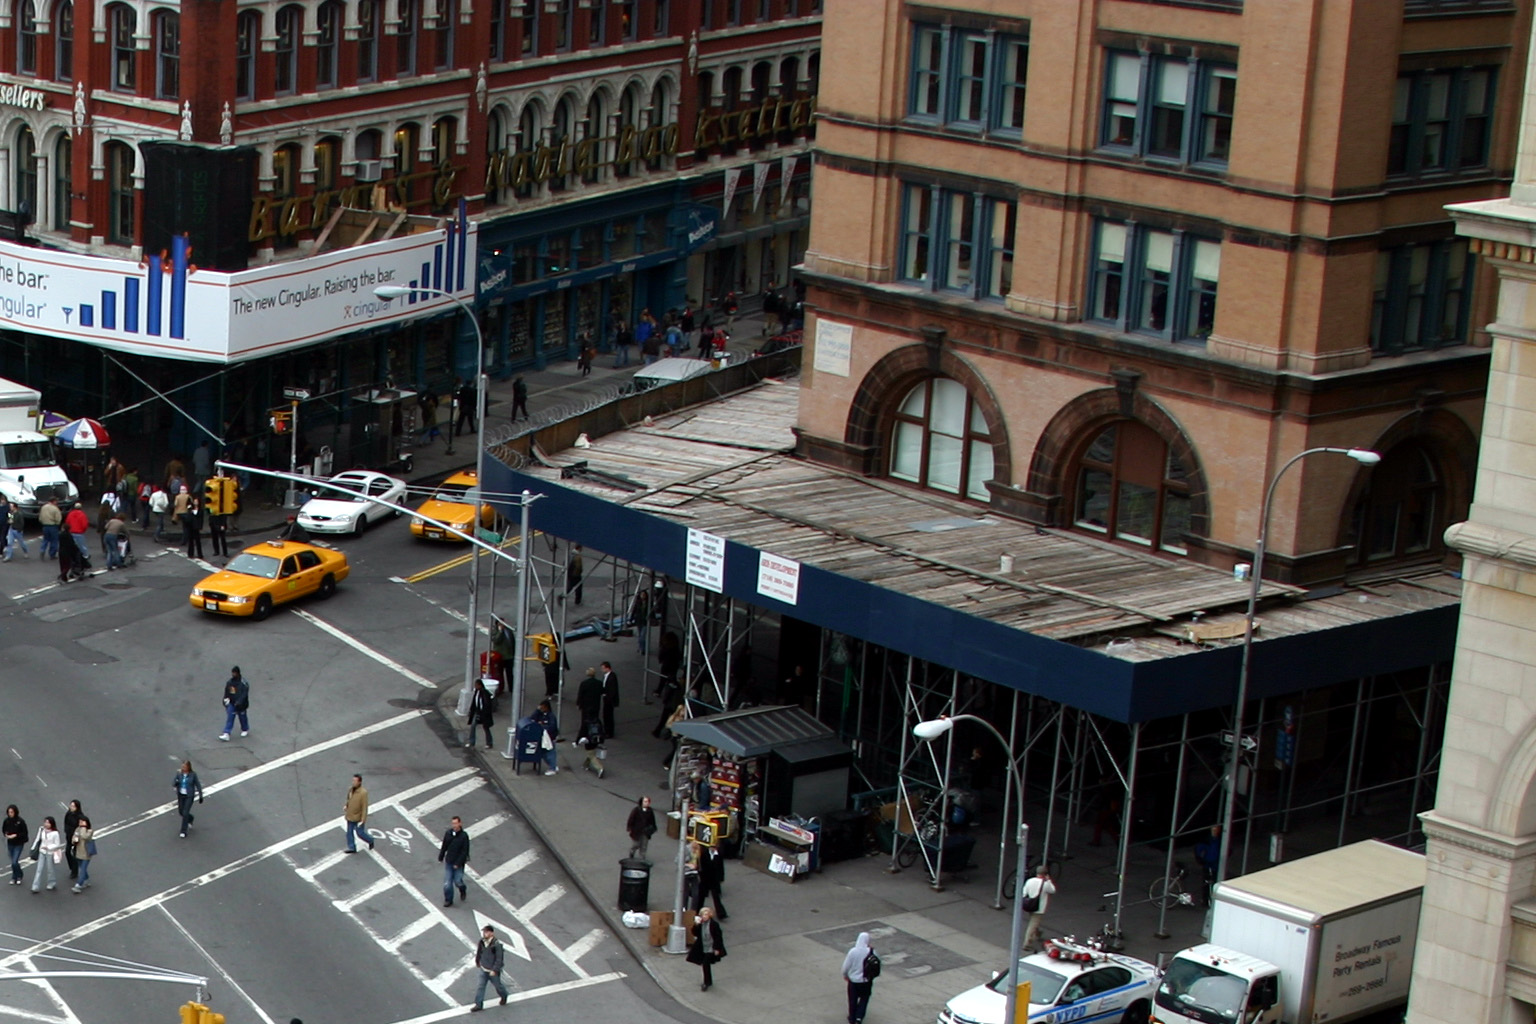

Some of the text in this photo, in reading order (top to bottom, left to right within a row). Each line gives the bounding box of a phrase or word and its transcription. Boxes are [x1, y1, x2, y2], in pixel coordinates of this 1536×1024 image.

[485, 132, 590, 192] Noble
[688, 220, 715, 244] Astor
[233, 298, 252, 315] The
[254, 296, 276, 311] new
[278, 284, 322, 307] Cingular.
[324, 275, 358, 297] Raising
[359, 269, 375, 287] the
[480, 269, 508, 294] Astor
[1335, 935, 1401, 963] Broadway Famous
[1333, 955, 1382, 978] Party Rentals
[1055, 1004, 1087, 1024] NYPD
